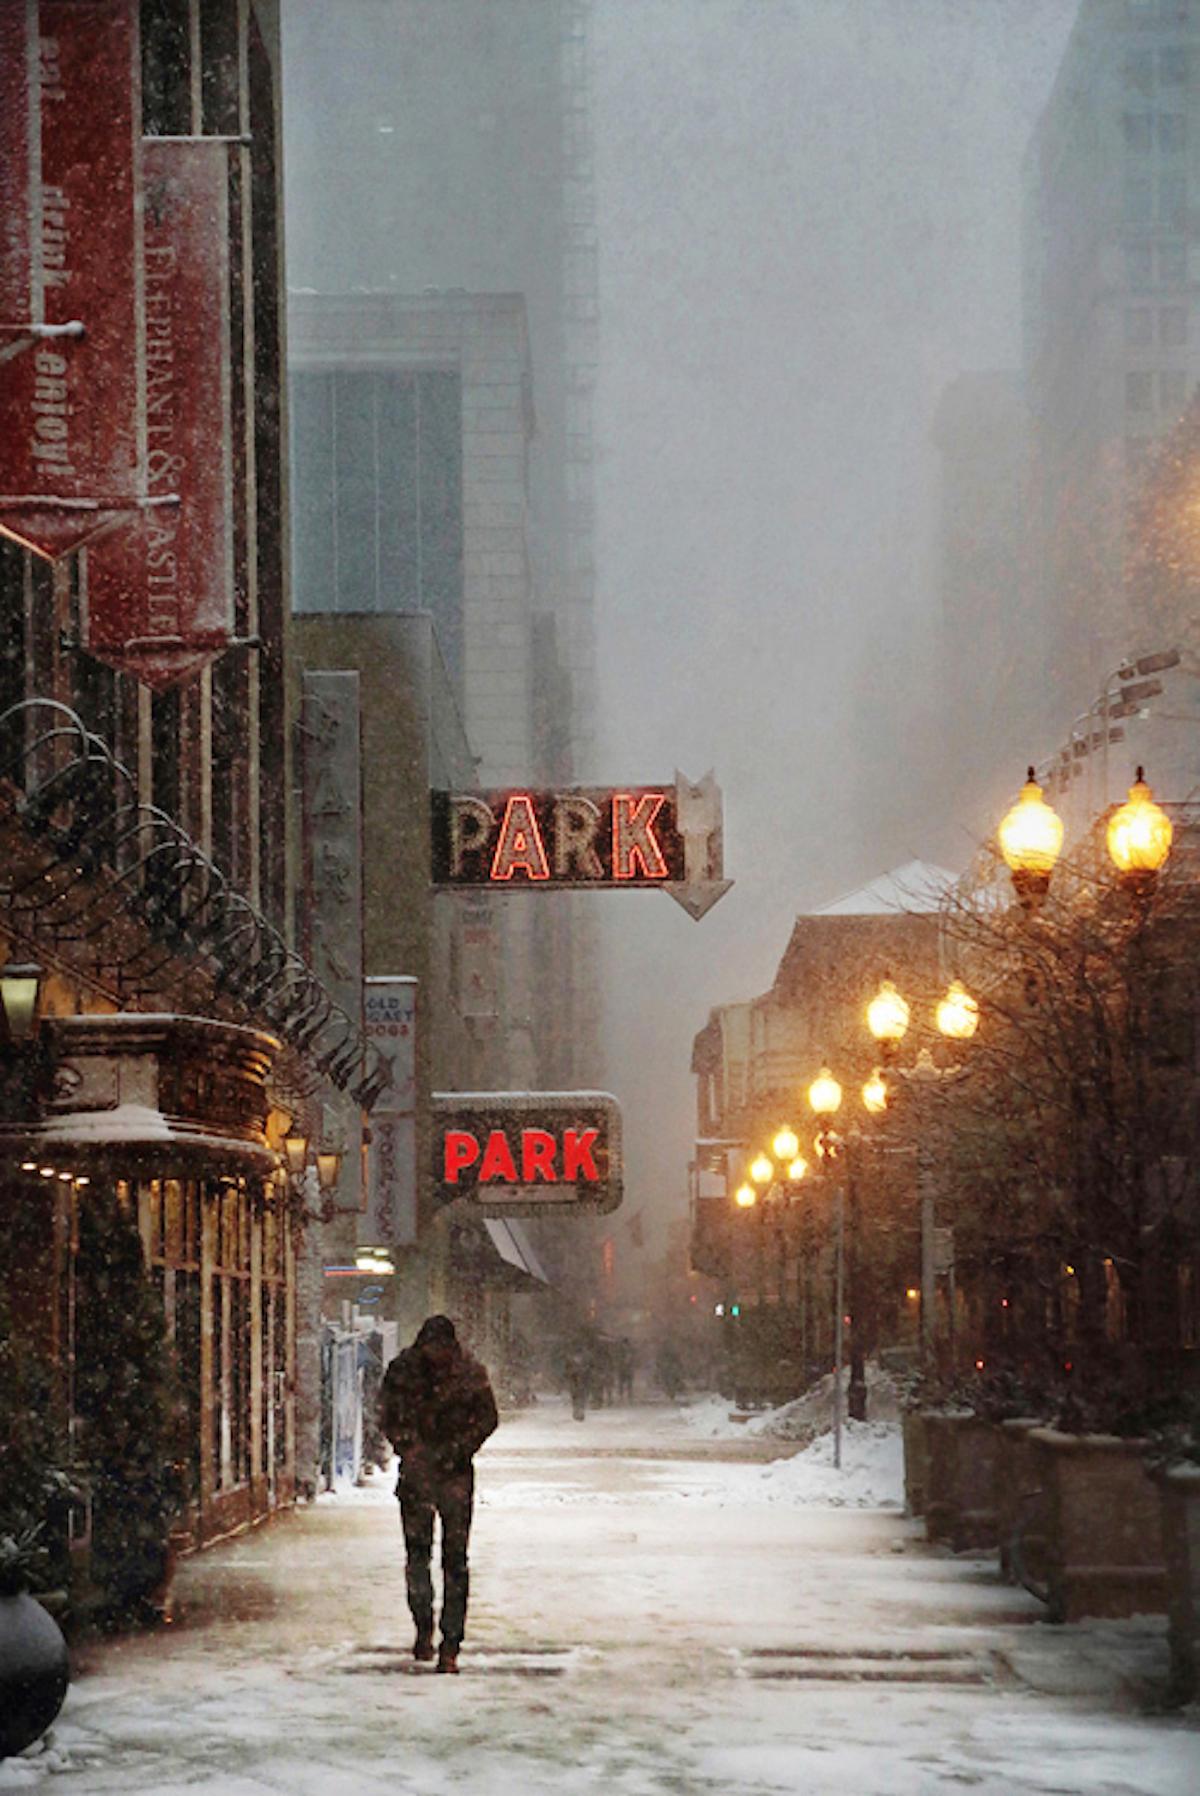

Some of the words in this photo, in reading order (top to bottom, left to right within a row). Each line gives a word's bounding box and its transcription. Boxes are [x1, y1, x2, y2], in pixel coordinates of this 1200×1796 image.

[41, 185, 72, 288] drink
[145, 246, 176, 444] ELEPHANT
[32, 352, 76, 476] enjoy!
[148, 449, 186, 484] &
[146, 503, 180, 634] CASTLE
[449, 793, 669, 881] PARK
[444, 1128, 600, 1184] PARK
